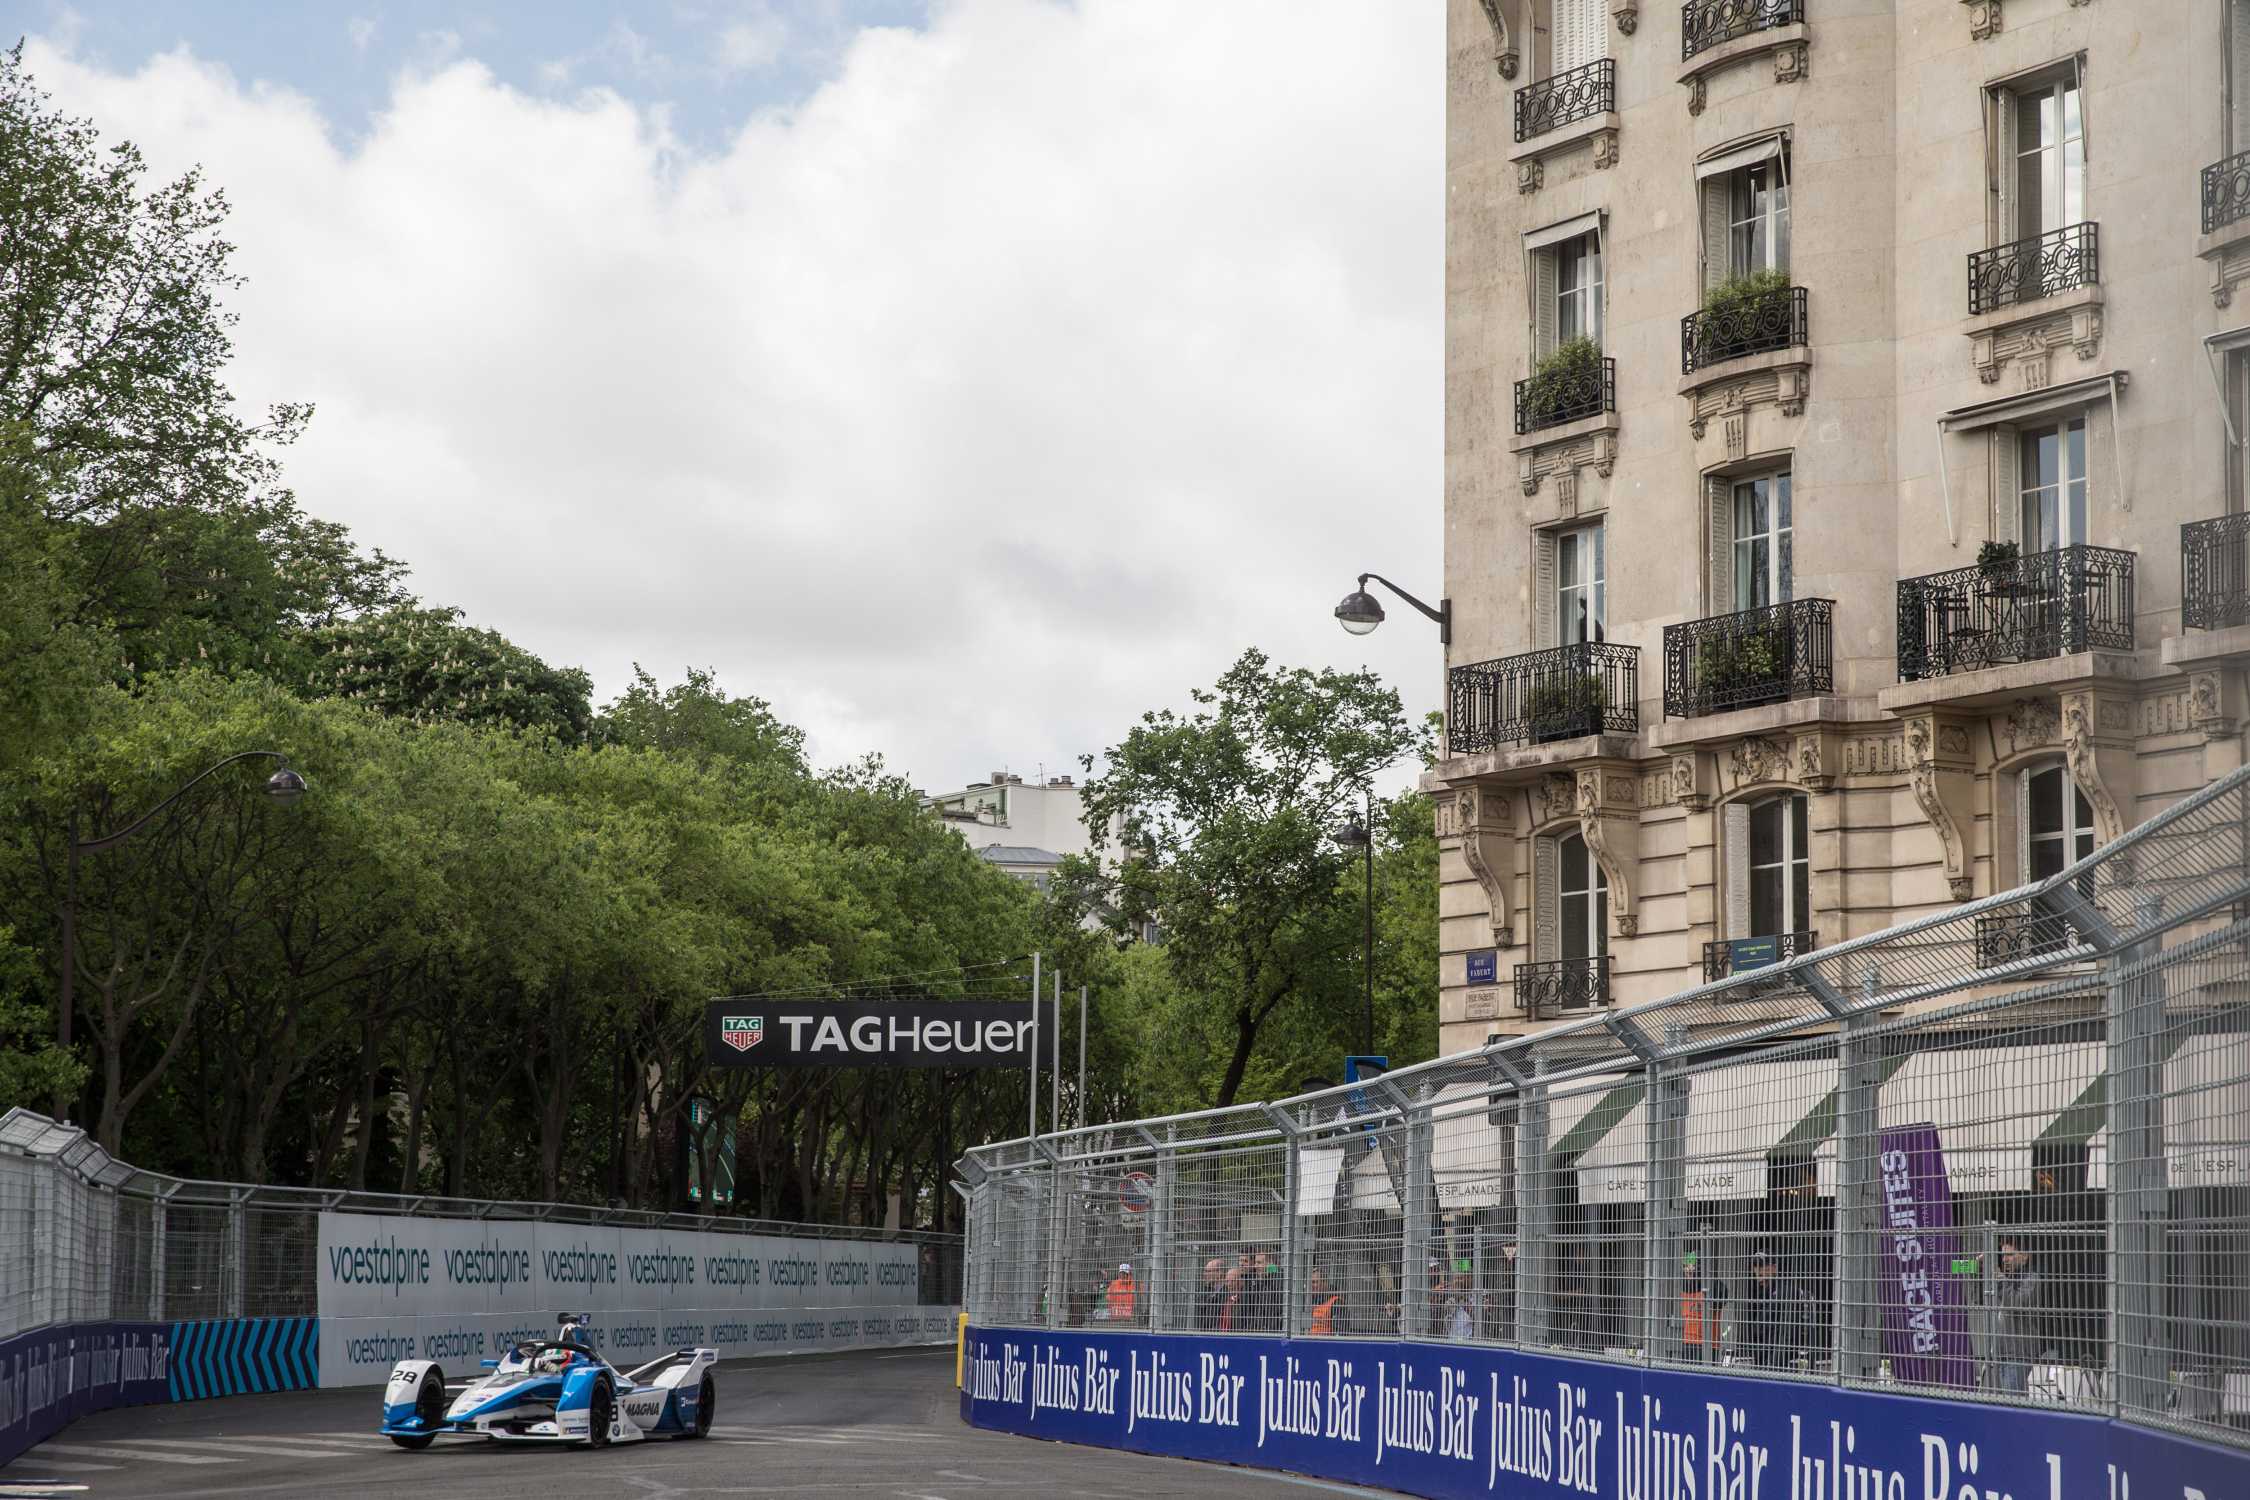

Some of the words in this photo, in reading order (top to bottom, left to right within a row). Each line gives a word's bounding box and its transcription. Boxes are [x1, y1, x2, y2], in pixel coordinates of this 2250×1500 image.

[725, 1032, 760, 1049] HEUER
[726, 1019, 759, 1030] TAG
[1687, 1176, 1734, 1189] LANADE
[1951, 1165, 1997, 1179] ANADE
[1881, 1150, 1923, 1262] SUITES
[329, 1234, 430, 1297] voestalpine
[444, 1237, 530, 1296] voestalpine
[542, 1240, 617, 1295] voestalpine
[627, 1245, 695, 1295] voestalpine
[704, 1247, 760, 1295] voestalpine
[767, 1249, 817, 1295] voestalpine
[824, 1251, 869, 1295] voestalpine
[875, 1255, 917, 1294] voestalpine
[1902, 1269, 1939, 1354] RACE
[346, 1327, 415, 1370] voestalpine
[423, 1325, 484, 1364] voestalpine
[610, 1320, 657, 1352] voestalpine
[663, 1320, 704, 1350] voestalpine
[120, 1332, 149, 1392] Julius
[150, 1332, 169, 1380] Bär
[391, 1369, 418, 1385] 28
[625, 1401, 660, 1417] MAGNA
[1003, 1343, 1027, 1404] Bär
[1031, 1344, 1079, 1421] Julius
[1085, 1347, 1120, 1415] Bär
[1128, 1350, 1192, 1434] Julius
[1199, 1352, 1245, 1427] Bär
[1258, 1355, 1321, 1448] Julius
[1326, 1358, 1366, 1443] Bär
[1376, 1361, 1435, 1465] Julius
[1439, 1365, 1479, 1461] Bär
[1489, 1372, 1552, 1491] Julius
[1558, 1382, 1602, 1495] Bär
[1706, 1402, 1768, 1500] Bär
